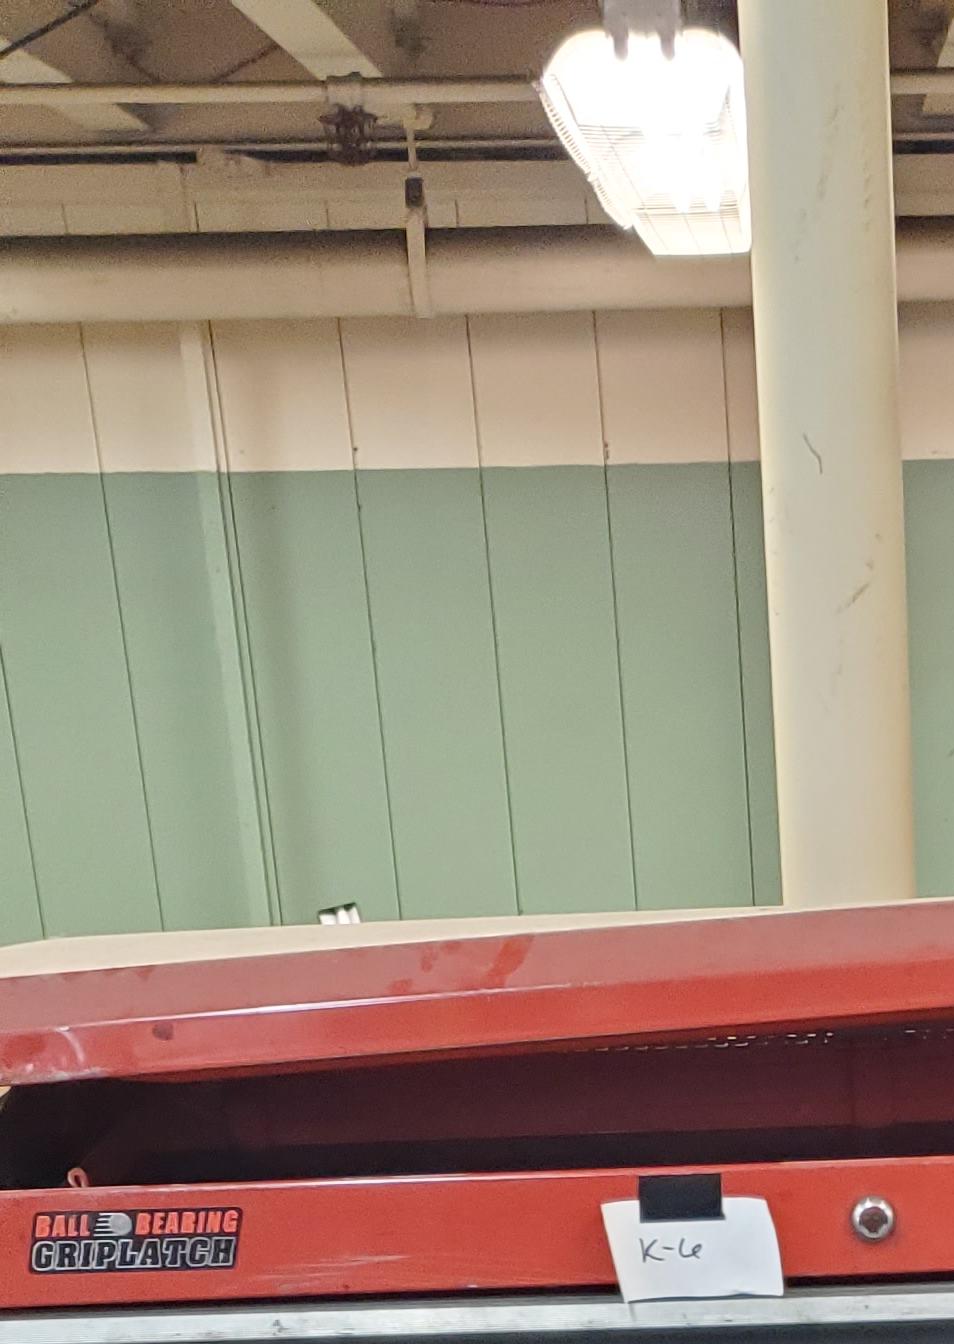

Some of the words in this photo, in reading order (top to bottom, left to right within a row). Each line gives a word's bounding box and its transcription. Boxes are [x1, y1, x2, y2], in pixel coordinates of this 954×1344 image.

[35, 1214, 91, 1238] BALL
[135, 1209, 240, 1236] BEARING
[31, 1236, 236, 1272] GRIPLATCH
